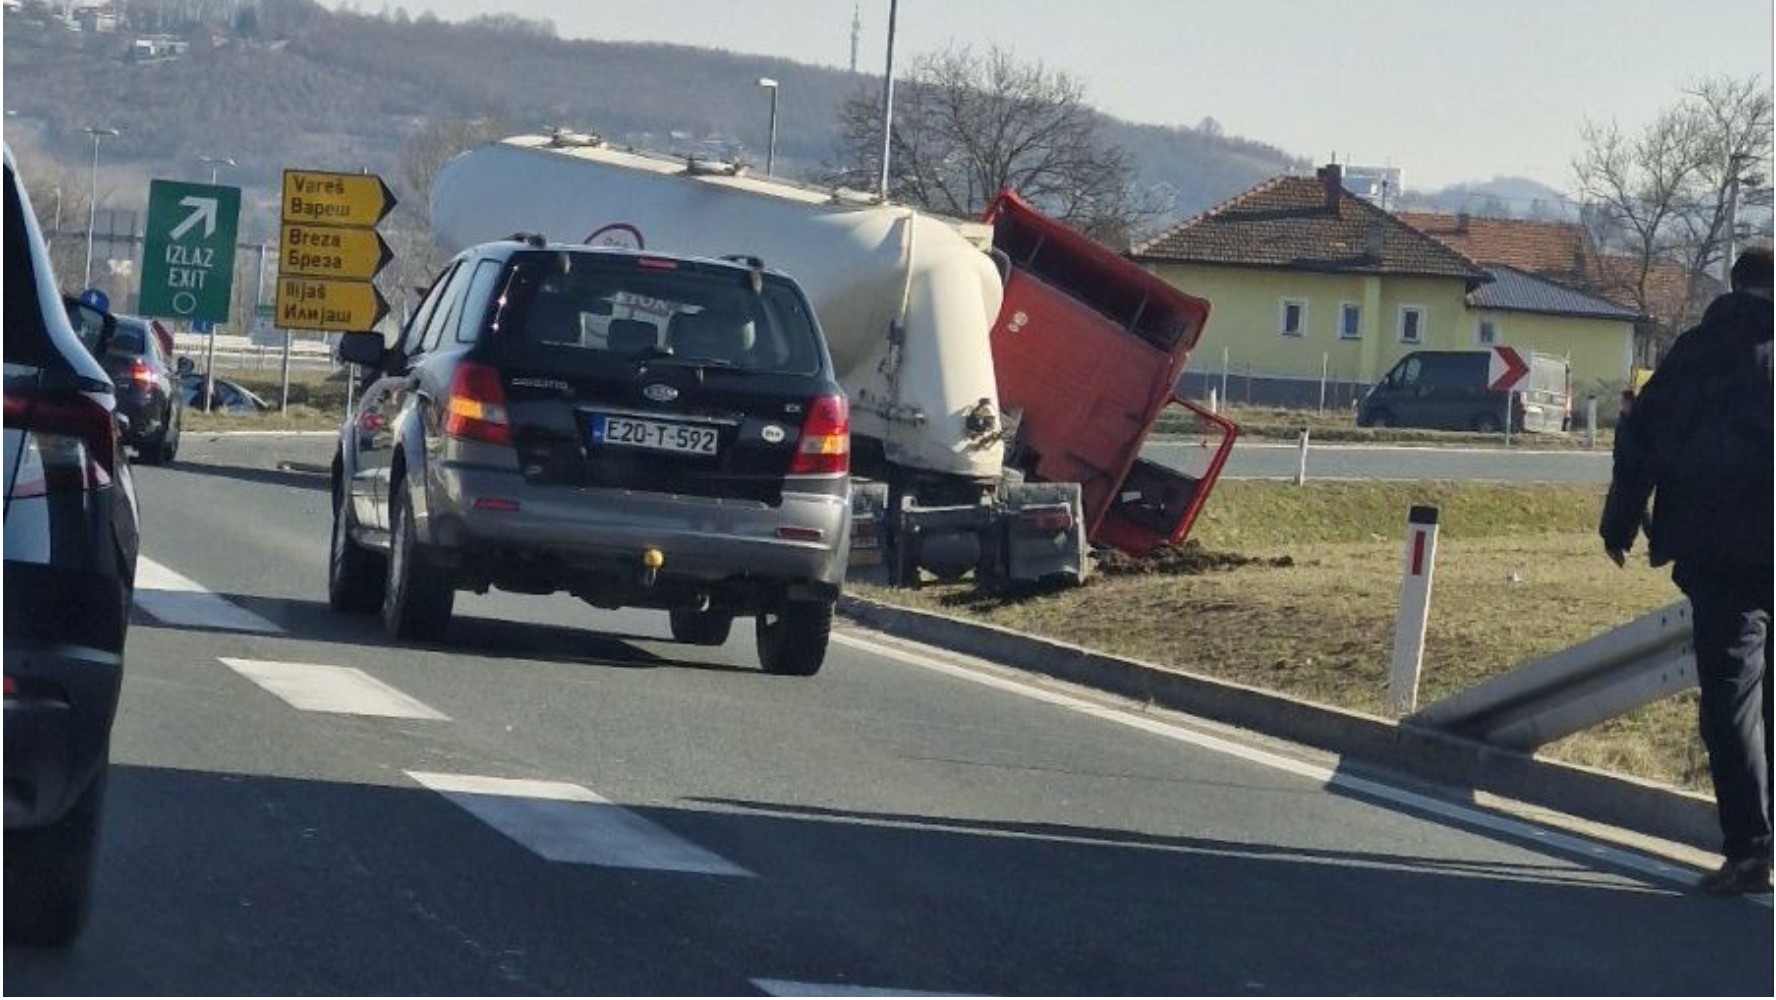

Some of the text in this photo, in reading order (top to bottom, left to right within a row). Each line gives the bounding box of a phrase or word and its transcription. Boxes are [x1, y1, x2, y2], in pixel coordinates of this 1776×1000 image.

[294, 176, 344, 195] Vareš
[291, 197, 350, 218] Вареш
[289, 229, 341, 248] Breza
[165, 244, 214, 268] IZLAZ
[287, 250, 342, 273] Бреза
[168, 268, 208, 289] EXIT
[284, 302, 352, 325] Илијаш
[606, 420, 715, 452] E20-T-592
